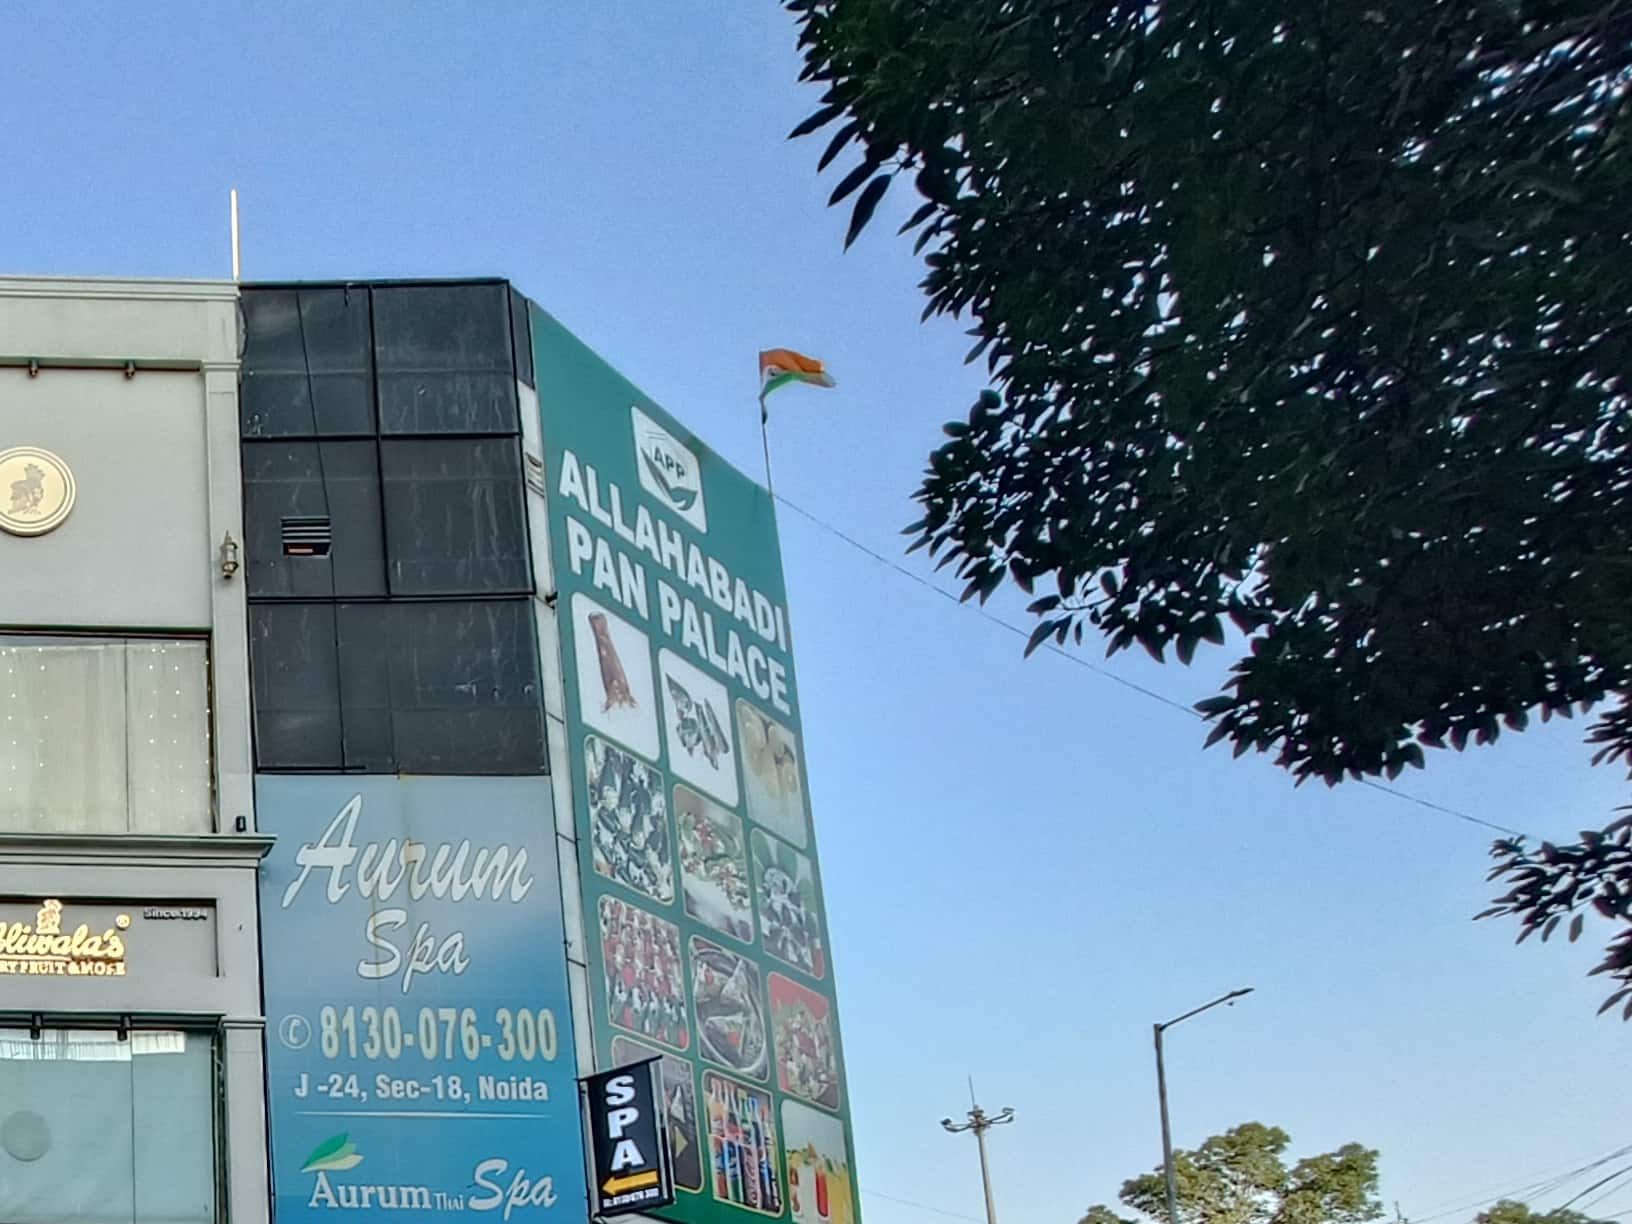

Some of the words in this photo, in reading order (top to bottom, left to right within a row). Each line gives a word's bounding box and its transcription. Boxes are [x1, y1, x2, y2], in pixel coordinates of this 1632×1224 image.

[654, 446, 687, 480] APP
[559, 449, 787, 653] ALLAHABADI
[566, 515, 649, 621] PAN
[657, 579, 791, 716] PALACE
[281, 792, 535, 909] Aurum
[356, 907, 472, 994] Spa
[319, 1004, 558, 1062] 8130-076-300
[375, 1074, 473, 1103] Sec-18,
[479, 1075, 549, 1102] Noida
[604, 1075, 645, 1172] SPA
[308, 1170, 432, 1210] Aurum
[468, 1159, 558, 1221] Spa
